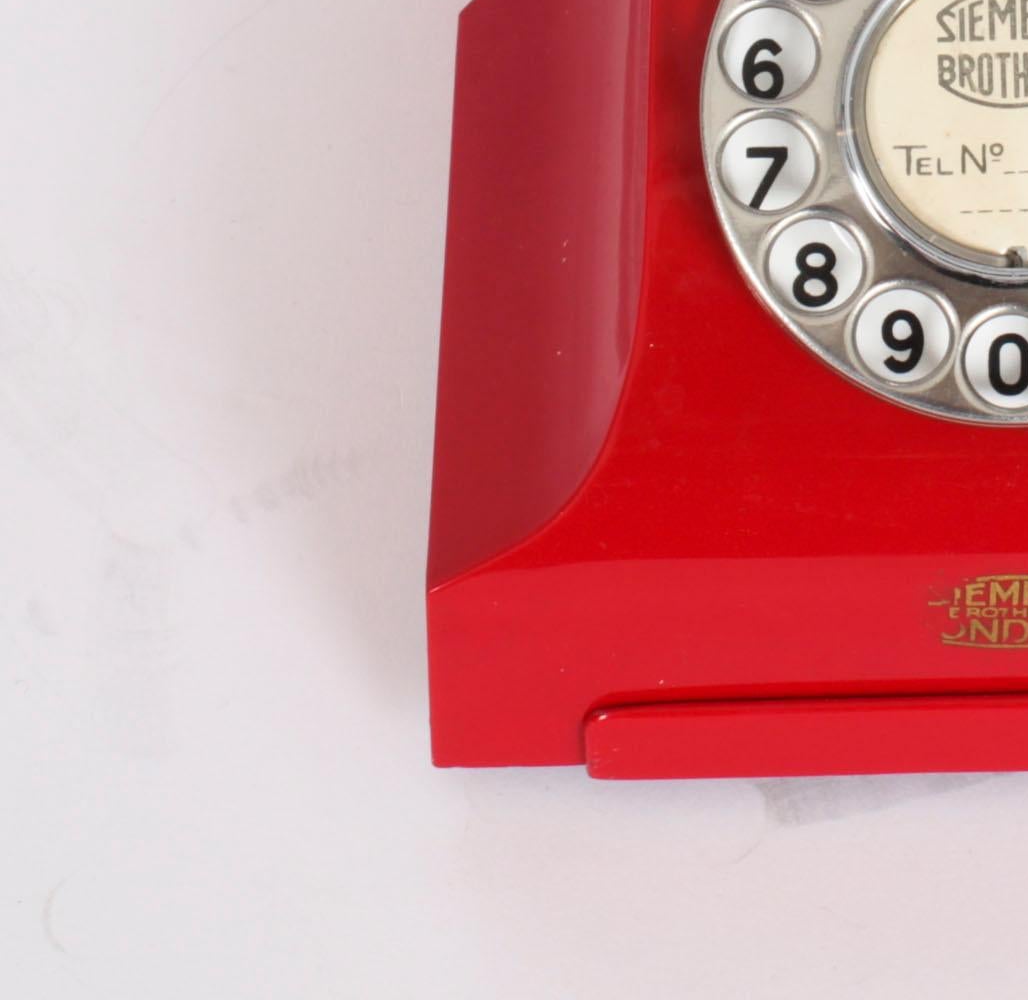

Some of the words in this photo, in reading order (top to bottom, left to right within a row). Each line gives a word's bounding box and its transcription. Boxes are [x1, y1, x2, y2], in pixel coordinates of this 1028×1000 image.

[742, 39, 785, 100] 6
[746, 146, 788, 210] 7
[793, 242, 838, 308] 8
[882, 310, 925, 374] 9
